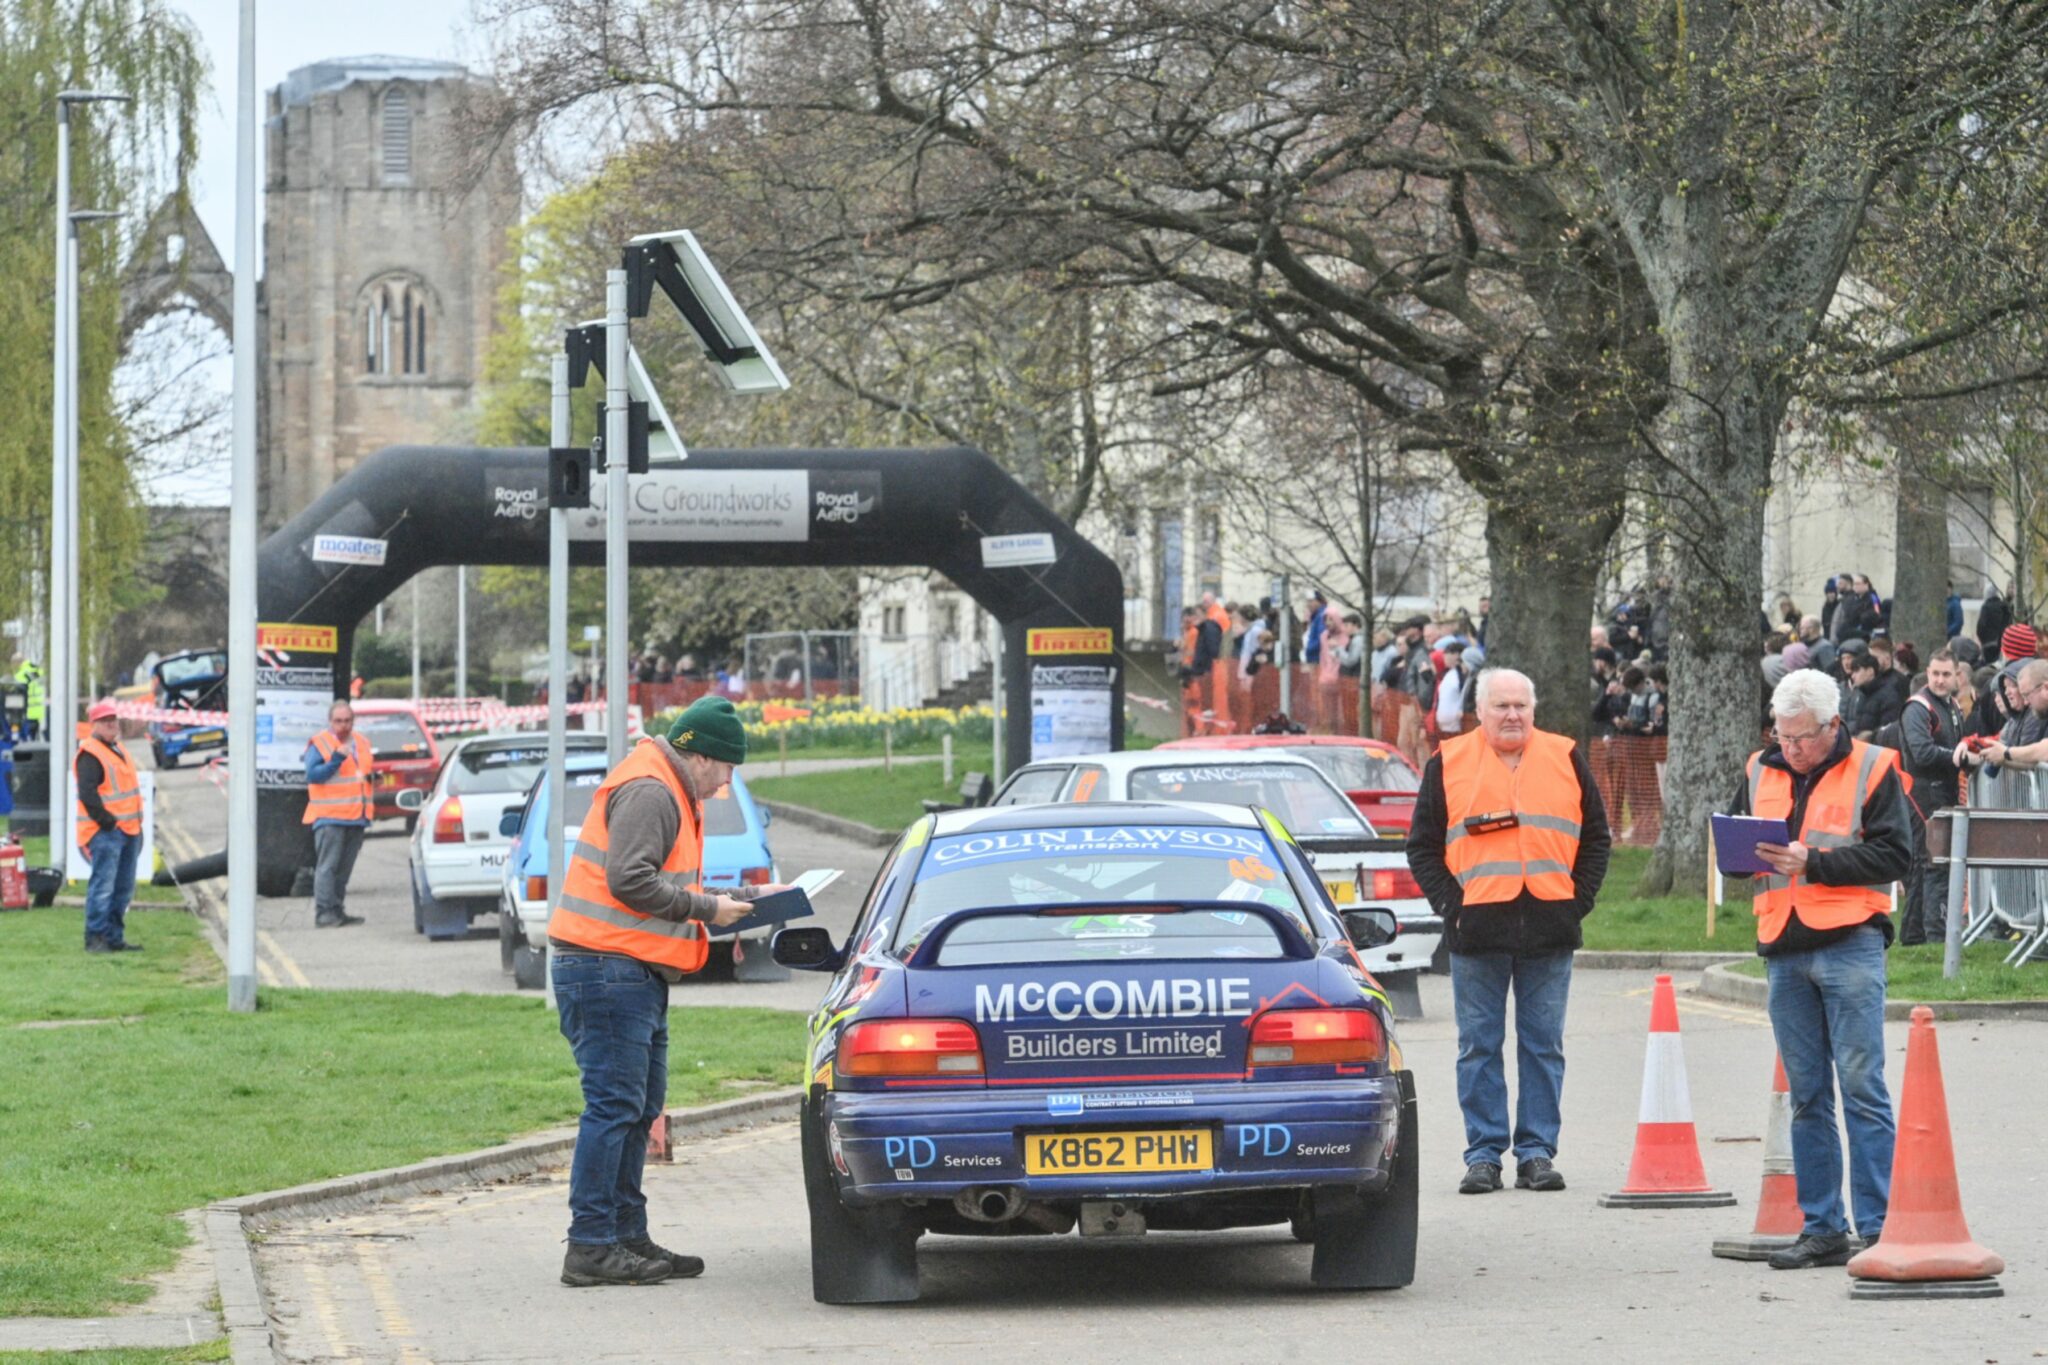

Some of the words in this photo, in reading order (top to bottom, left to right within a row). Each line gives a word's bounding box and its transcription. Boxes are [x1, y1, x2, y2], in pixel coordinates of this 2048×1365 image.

[494, 486, 539, 503] Royal
[663, 482, 793, 514] Groundworks
[815, 490, 859, 506] Royal
[319, 539, 384, 555] moates
[1032, 630, 1109, 651] PIRELLI
[1189, 767, 1237, 782] KNC
[933, 830, 1067, 862] COLIN
[1082, 827, 1267, 854] LAWSON
[1042, 839, 1160, 852] Transport
[1228, 855, 1276, 882] 46
[1007, 1033, 1118, 1058] Builders
[1125, 1029, 1223, 1056] Limited
[884, 1135, 937, 1168] PD
[943, 1154, 1003, 1167] Services
[1038, 1136, 1126, 1169] K862
[1134, 1133, 1199, 1166] PHW
[1238, 1123, 1293, 1157] PD
[1296, 1141, 1352, 1157] Services
